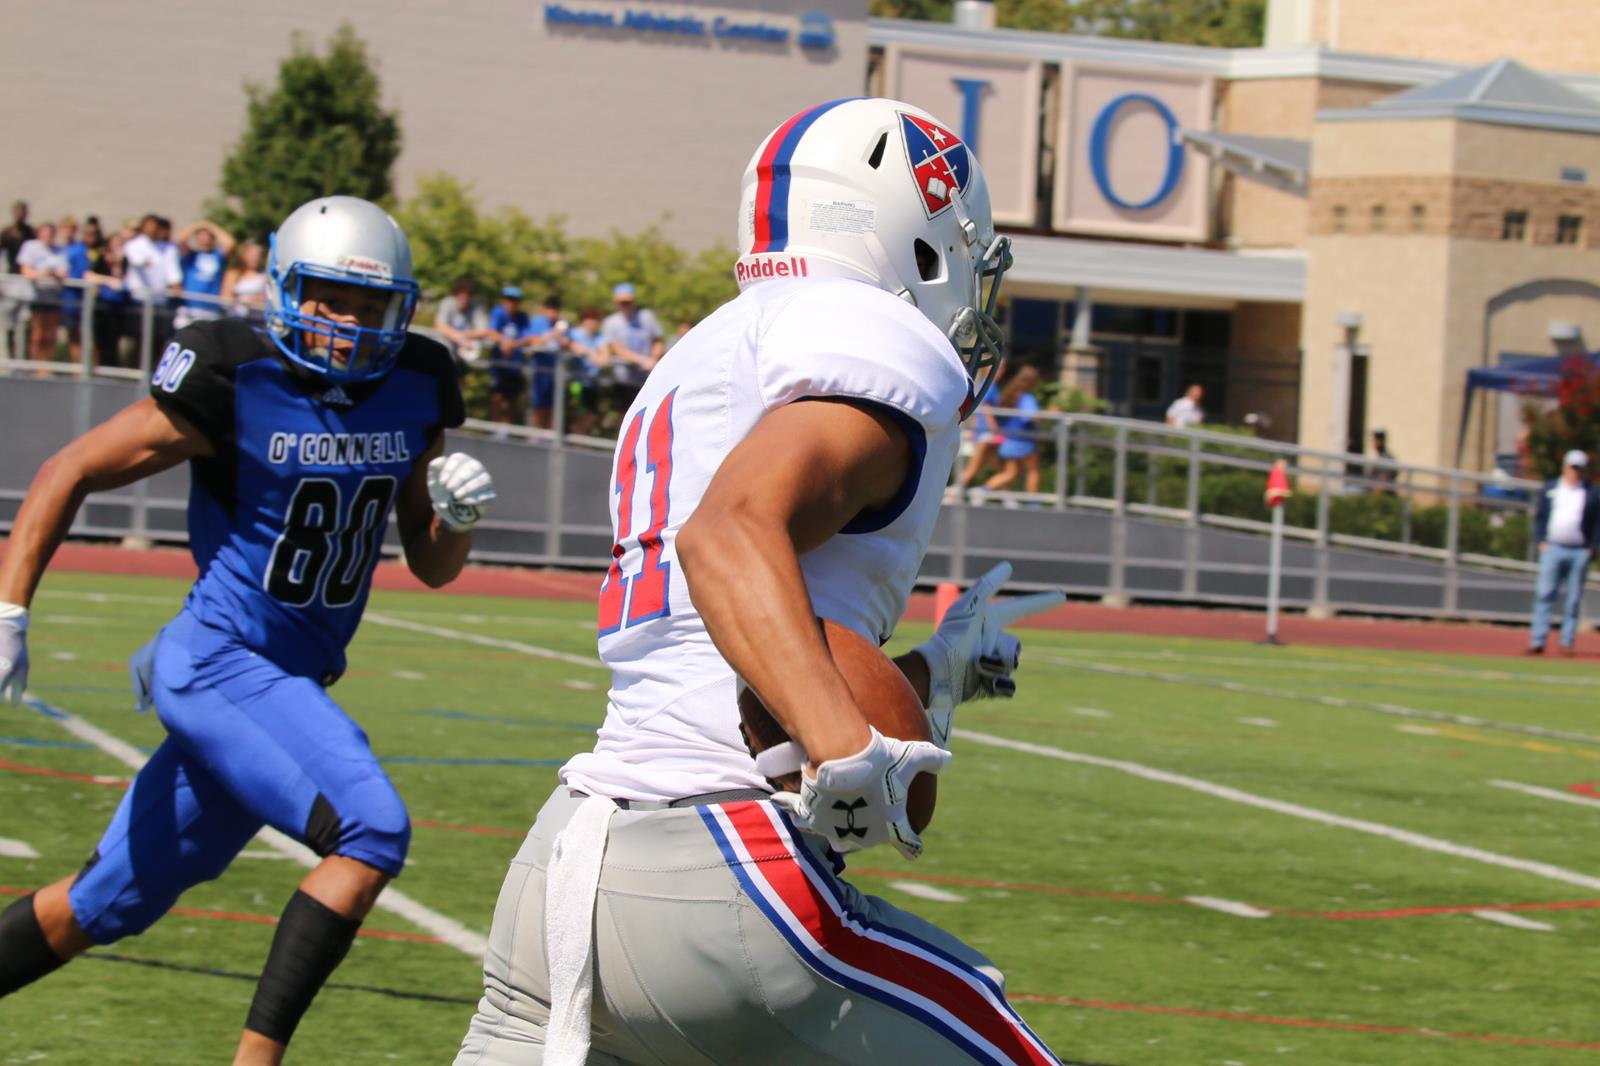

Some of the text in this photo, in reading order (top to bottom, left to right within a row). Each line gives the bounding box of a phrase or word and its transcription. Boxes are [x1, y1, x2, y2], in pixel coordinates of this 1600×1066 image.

[736, 257, 807, 281] Riddell
[151, 342, 197, 393] 80
[268, 430, 410, 466] O'CONNELL
[598, 385, 680, 639] 11
[264, 475, 397, 609] 80
